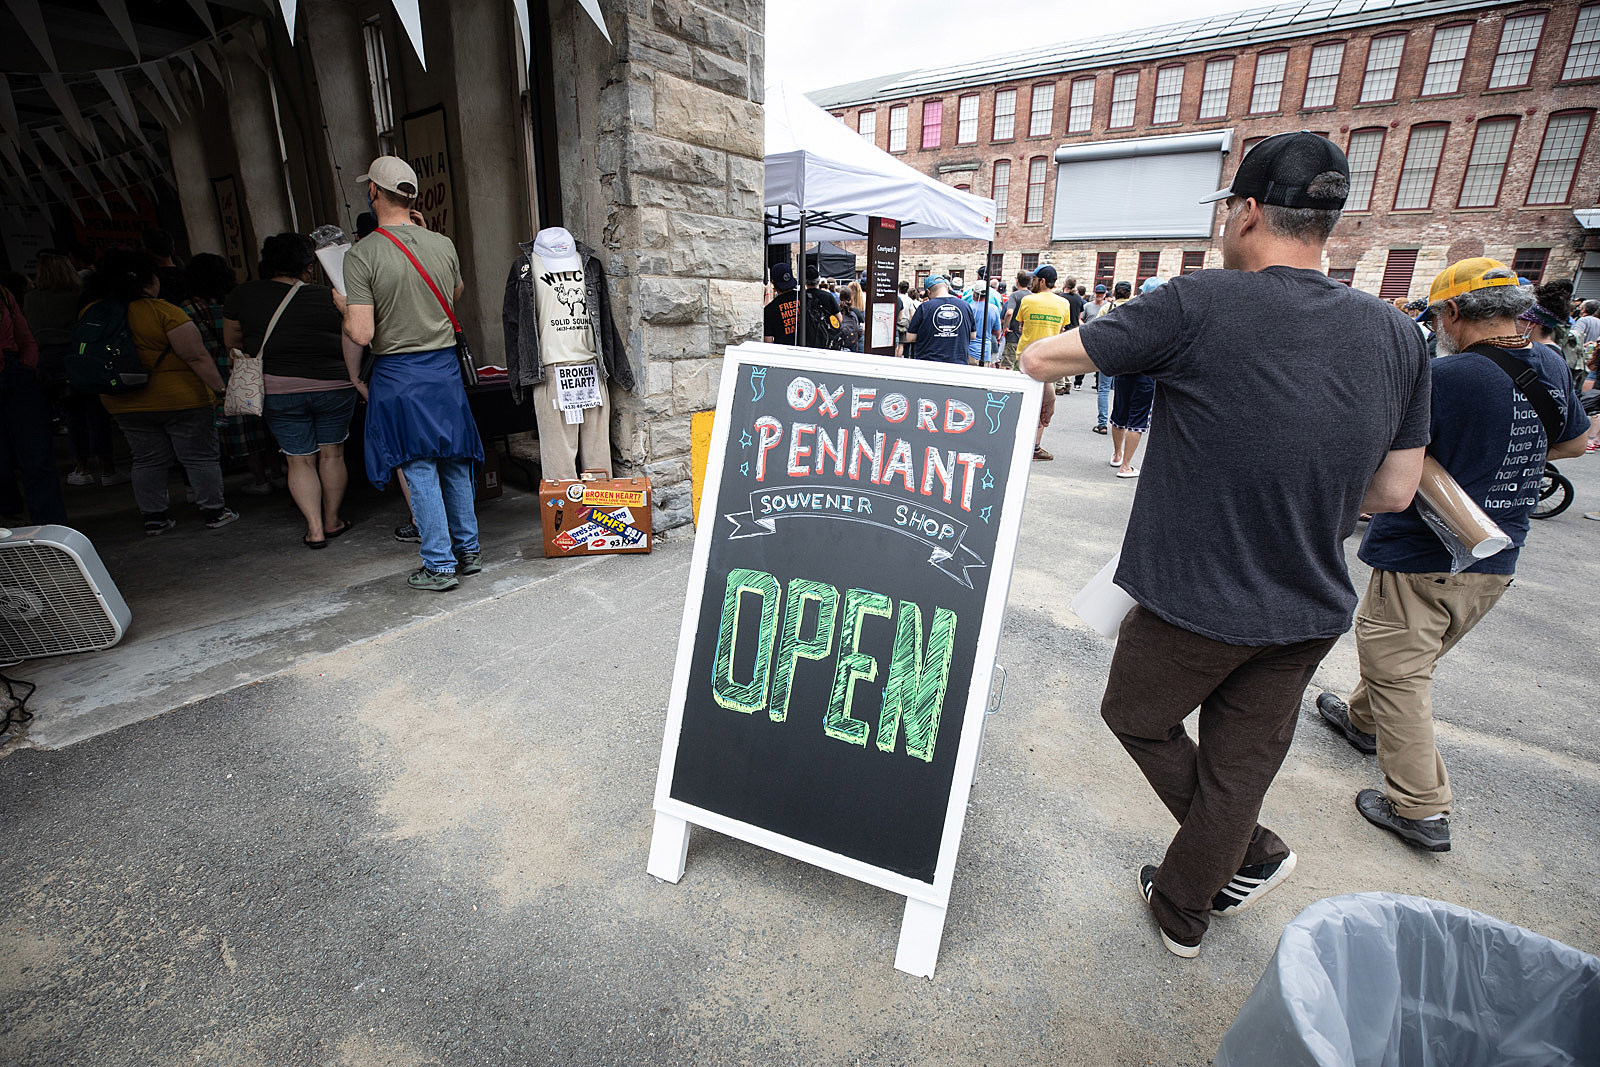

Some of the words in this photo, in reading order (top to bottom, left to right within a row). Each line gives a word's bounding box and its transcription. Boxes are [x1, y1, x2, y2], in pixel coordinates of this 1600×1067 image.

[539, 270, 583, 287] WILC
[780, 308, 800, 320] MUS
[550, 318, 571, 327] SOLID
[558, 366, 594, 379] BROKEN
[560, 376, 596, 390] HEART?
[786, 376, 976, 434] OXFORD
[1513, 406, 1538, 420] hare
[1510, 423, 1539, 436] krsna
[1507, 440, 1532, 453] hare
[754, 415, 987, 512] PENNANT
[1502, 453, 1529, 466] hare
[585, 490, 614, 499] BROKEN
[615, 492, 642, 500] HEART?
[1484, 495, 1511, 508] hare
[592, 509, 626, 533] WHFS
[760, 491, 874, 515] SOUVENIR
[894, 506, 955, 541] SHOP
[609, 539, 621, 548] 93
[711, 568, 958, 763] OPEN
